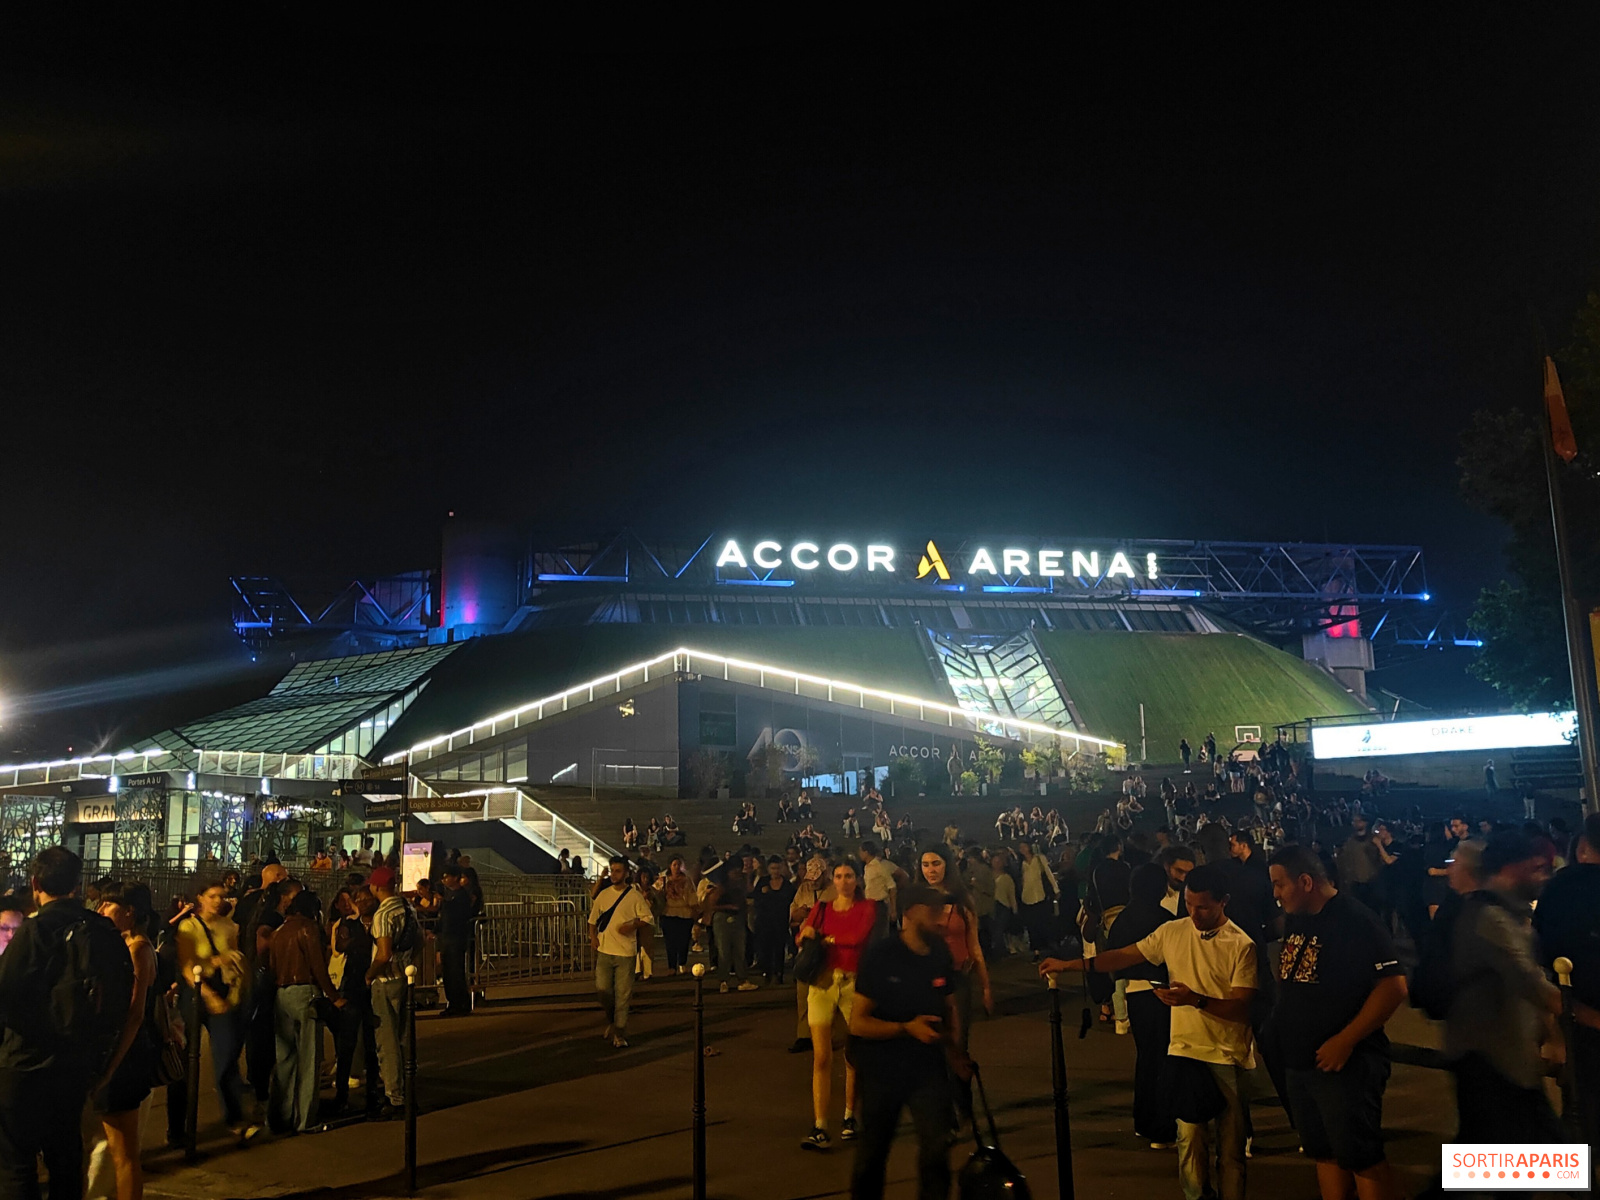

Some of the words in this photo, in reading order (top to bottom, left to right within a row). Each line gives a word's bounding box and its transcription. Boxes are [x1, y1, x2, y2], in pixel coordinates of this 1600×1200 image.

[715, 539, 896, 572] ACCOR
[967, 547, 1136, 579] ARENA
[1431, 725, 1476, 736] DRAKE
[888, 744, 941, 759] ACCOR
[128, 777, 145, 787] Portes
[409, 801, 428, 810] Loges
[437, 800, 460, 808] Salons
